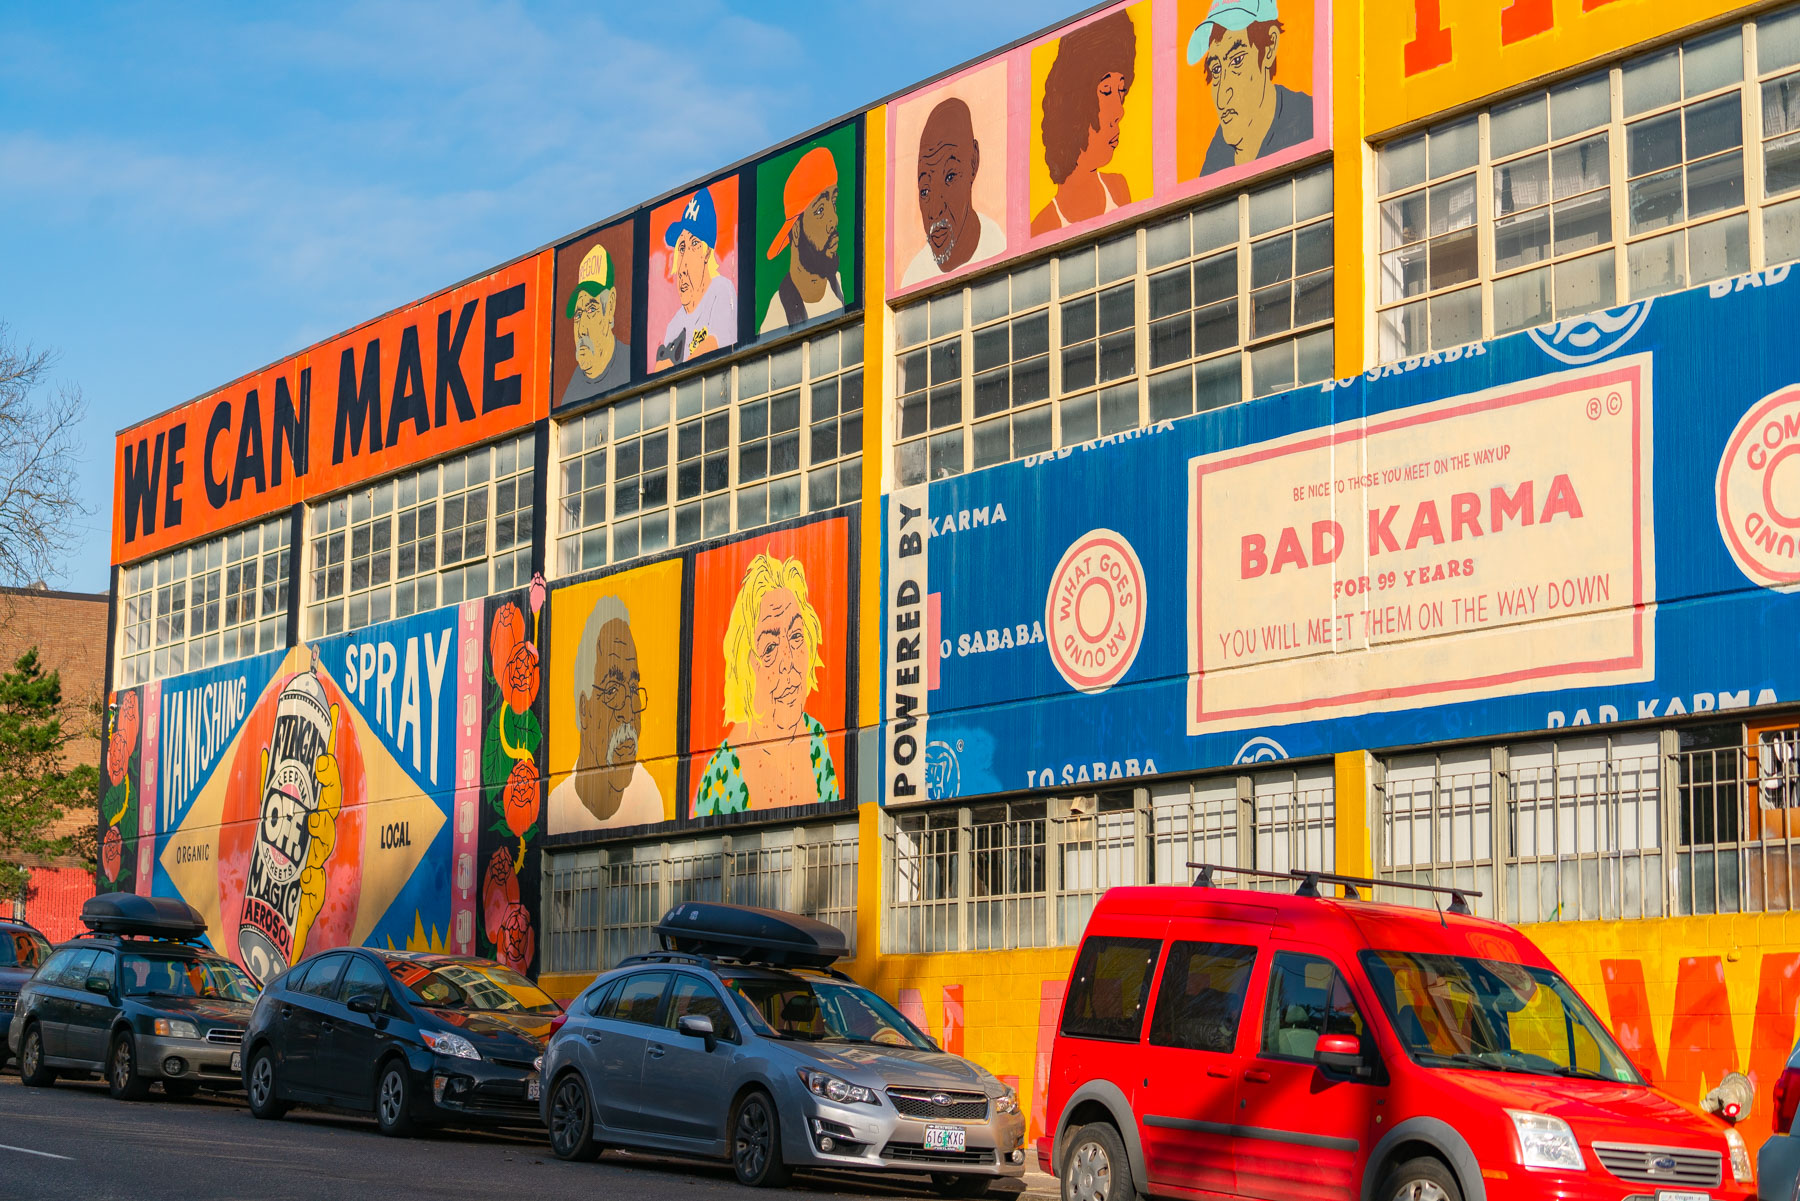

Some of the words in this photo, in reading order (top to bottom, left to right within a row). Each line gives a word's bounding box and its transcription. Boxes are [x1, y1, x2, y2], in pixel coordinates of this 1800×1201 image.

[124, 422, 187, 545] WE
[203, 366, 312, 510] CAN
[331, 282, 526, 466] MAKE
[1293, 486, 1305, 502] BE
[1308, 481, 1330, 499] NICE
[1334, 479, 1345, 494] TO
[1347, 472, 1379, 490] THOSE
[1382, 467, 1401, 485] YOU
[1403, 461, 1431, 481] MEET
[1433, 456, 1449, 475] ON
[1450, 452, 1471, 471] THE
[899, 503, 923, 559] BY
[928, 503, 1007, 538] KARMA
[1240, 519, 1345, 580] BAD
[1368, 473, 1584, 557] KARMA
[1059, 557, 1093, 621] WHAT
[1100, 553, 1133, 608] GOES
[1332, 574, 1372, 600] FOR
[1377, 570, 1397, 592] 99
[1403, 557, 1475, 587] YEARS
[958, 621, 1045, 657] SABABA
[1064, 622, 1127, 668] AROUND
[1218, 628, 1257, 661] YOU
[1261, 623, 1301, 651] WILL
[1307, 613, 1354, 645] MEET
[1360, 601, 1412, 638] THEM
[1418, 601, 1444, 631] ON
[1452, 594, 1488, 626] THE
[1497, 584, 1539, 618] WAY
[1547, 573, 1611, 610] DOWN
[344, 627, 453, 787] SPRAY
[893, 579, 922, 799] POWERED
[161, 674, 247, 833] VANISHING
[176, 843, 210, 865] ORGANIC
[264, 847, 293, 879] STREETS
[380, 821, 411, 849] LOCAL
[246, 844, 301, 927] MAGIC
[244, 902, 291, 960] AEROSOL
[926, 1130, 942, 1144] 616
[947, 1131, 964, 1146] KXG
